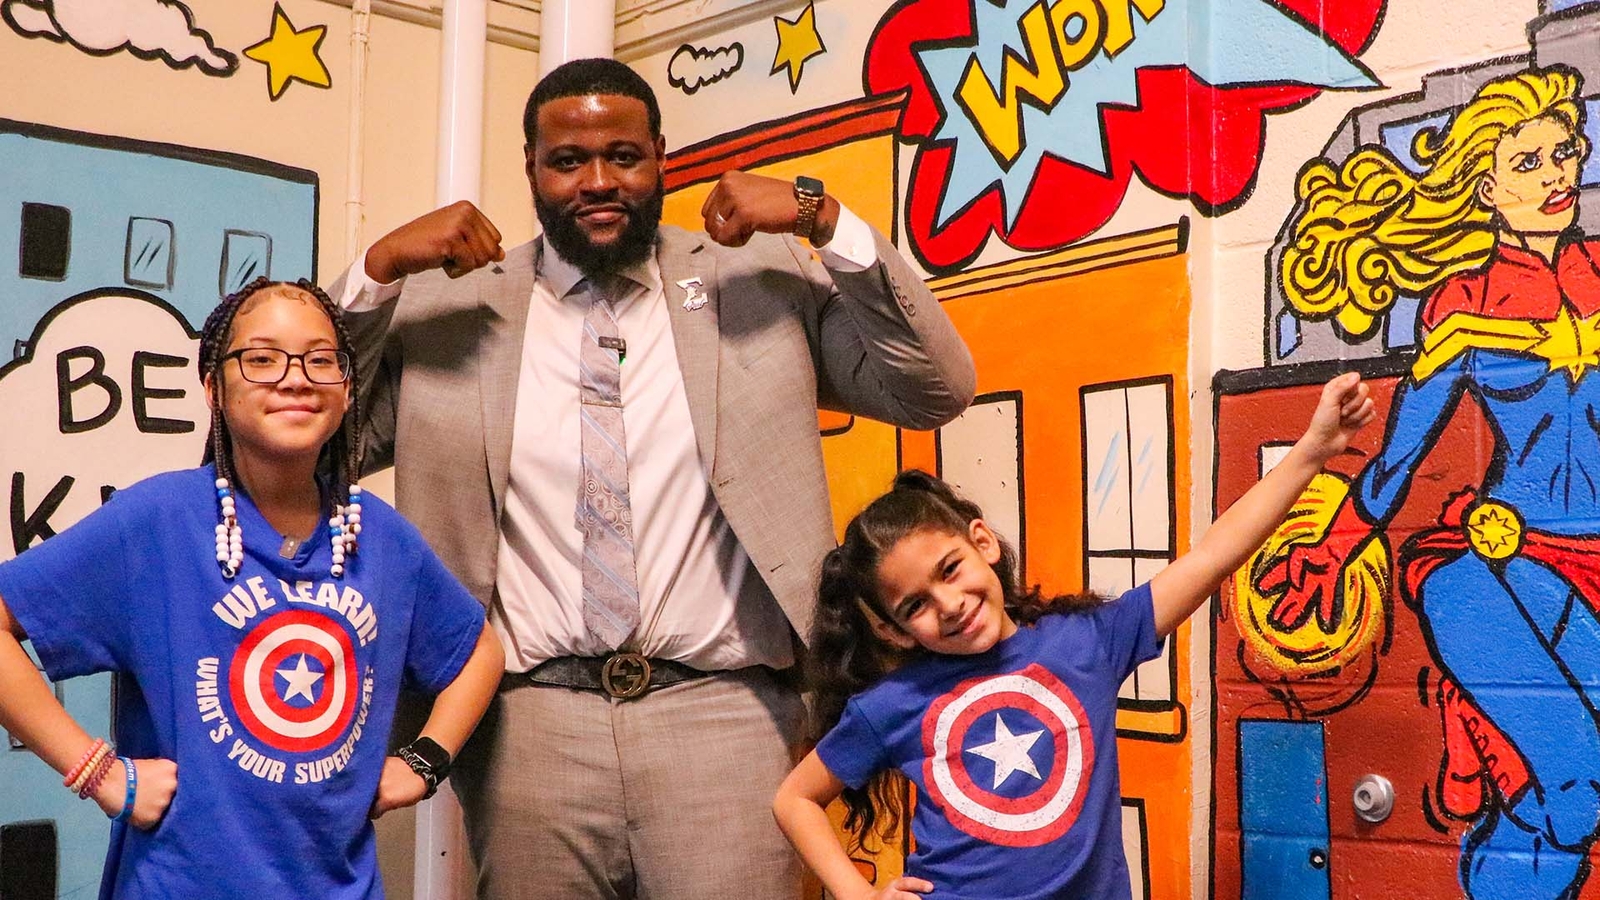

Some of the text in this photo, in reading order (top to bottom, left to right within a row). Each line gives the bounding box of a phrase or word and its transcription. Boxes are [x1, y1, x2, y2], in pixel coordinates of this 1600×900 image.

[57, 346, 195, 434] BE
[212, 576, 276, 629] WE
[196, 657, 233, 744] WHAT'S
[227, 738, 286, 784] YOUR
